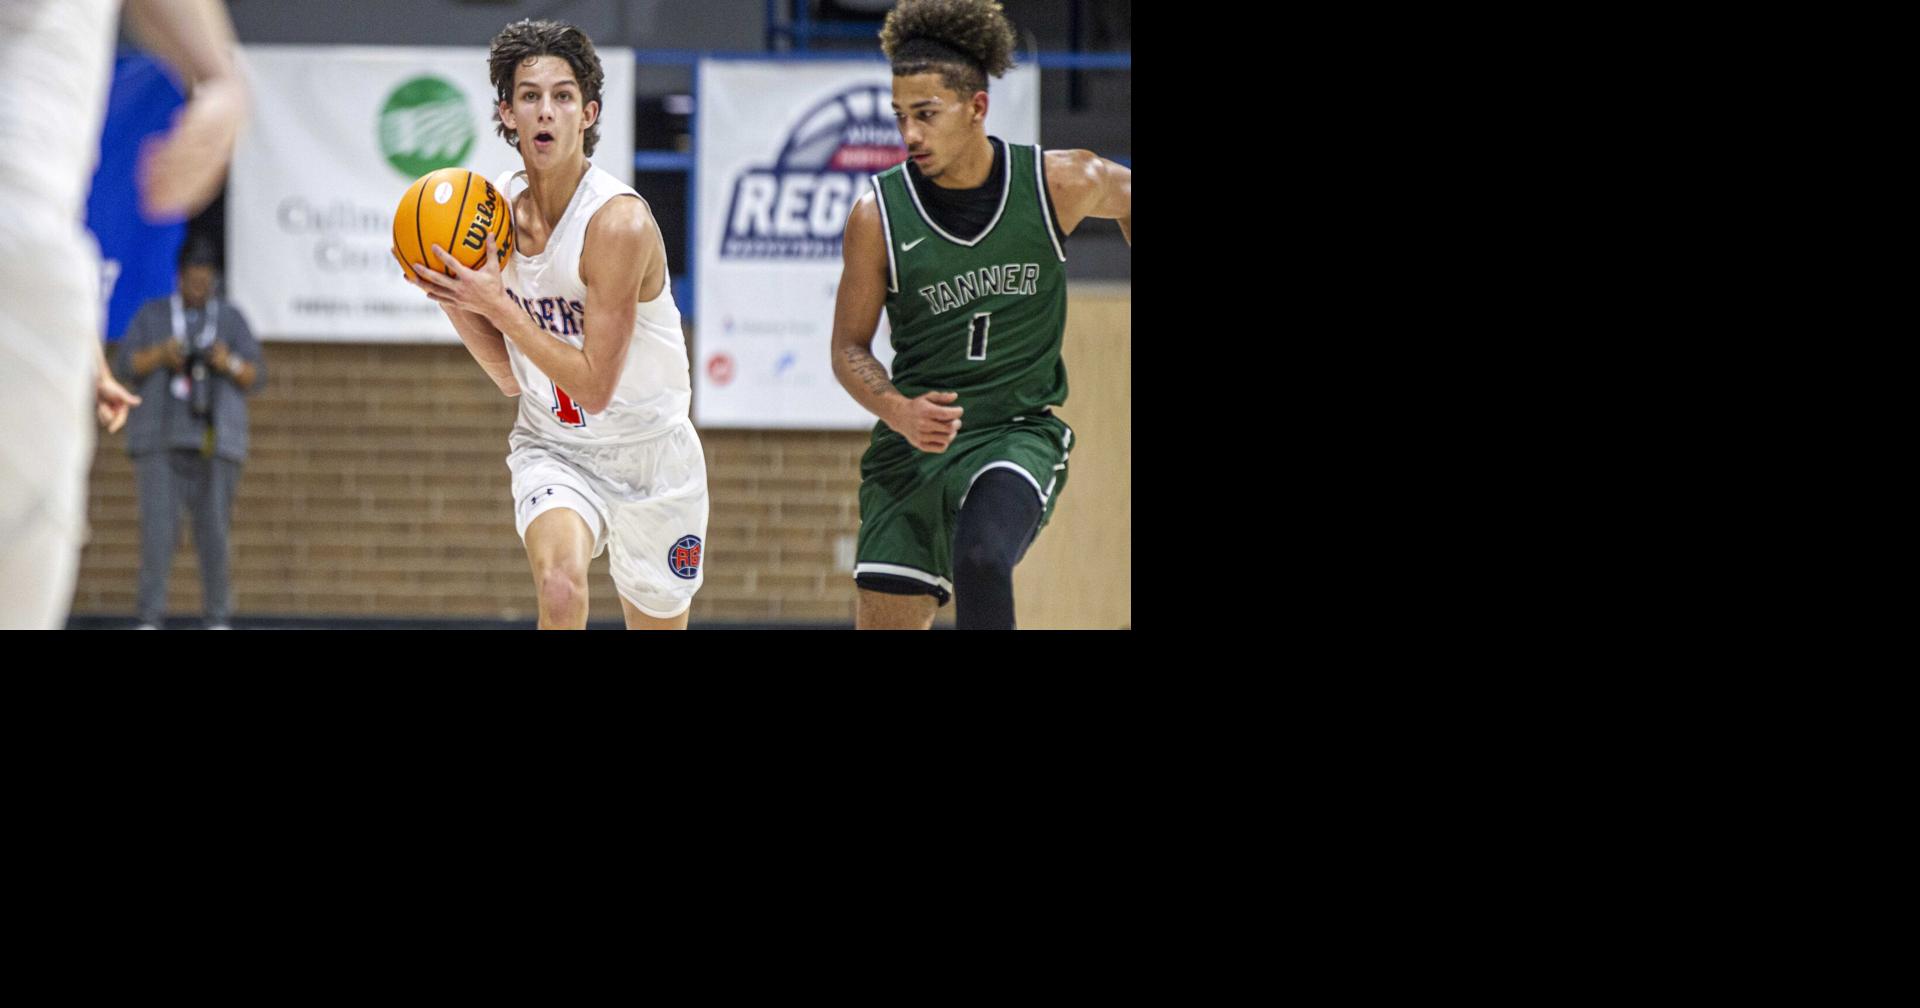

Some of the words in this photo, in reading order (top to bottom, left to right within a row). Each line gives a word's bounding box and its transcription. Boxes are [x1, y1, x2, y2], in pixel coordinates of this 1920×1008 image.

[462, 181, 497, 250] Wilson
[919, 263, 1039, 315] TANNER
[967, 311, 992, 361] 1
